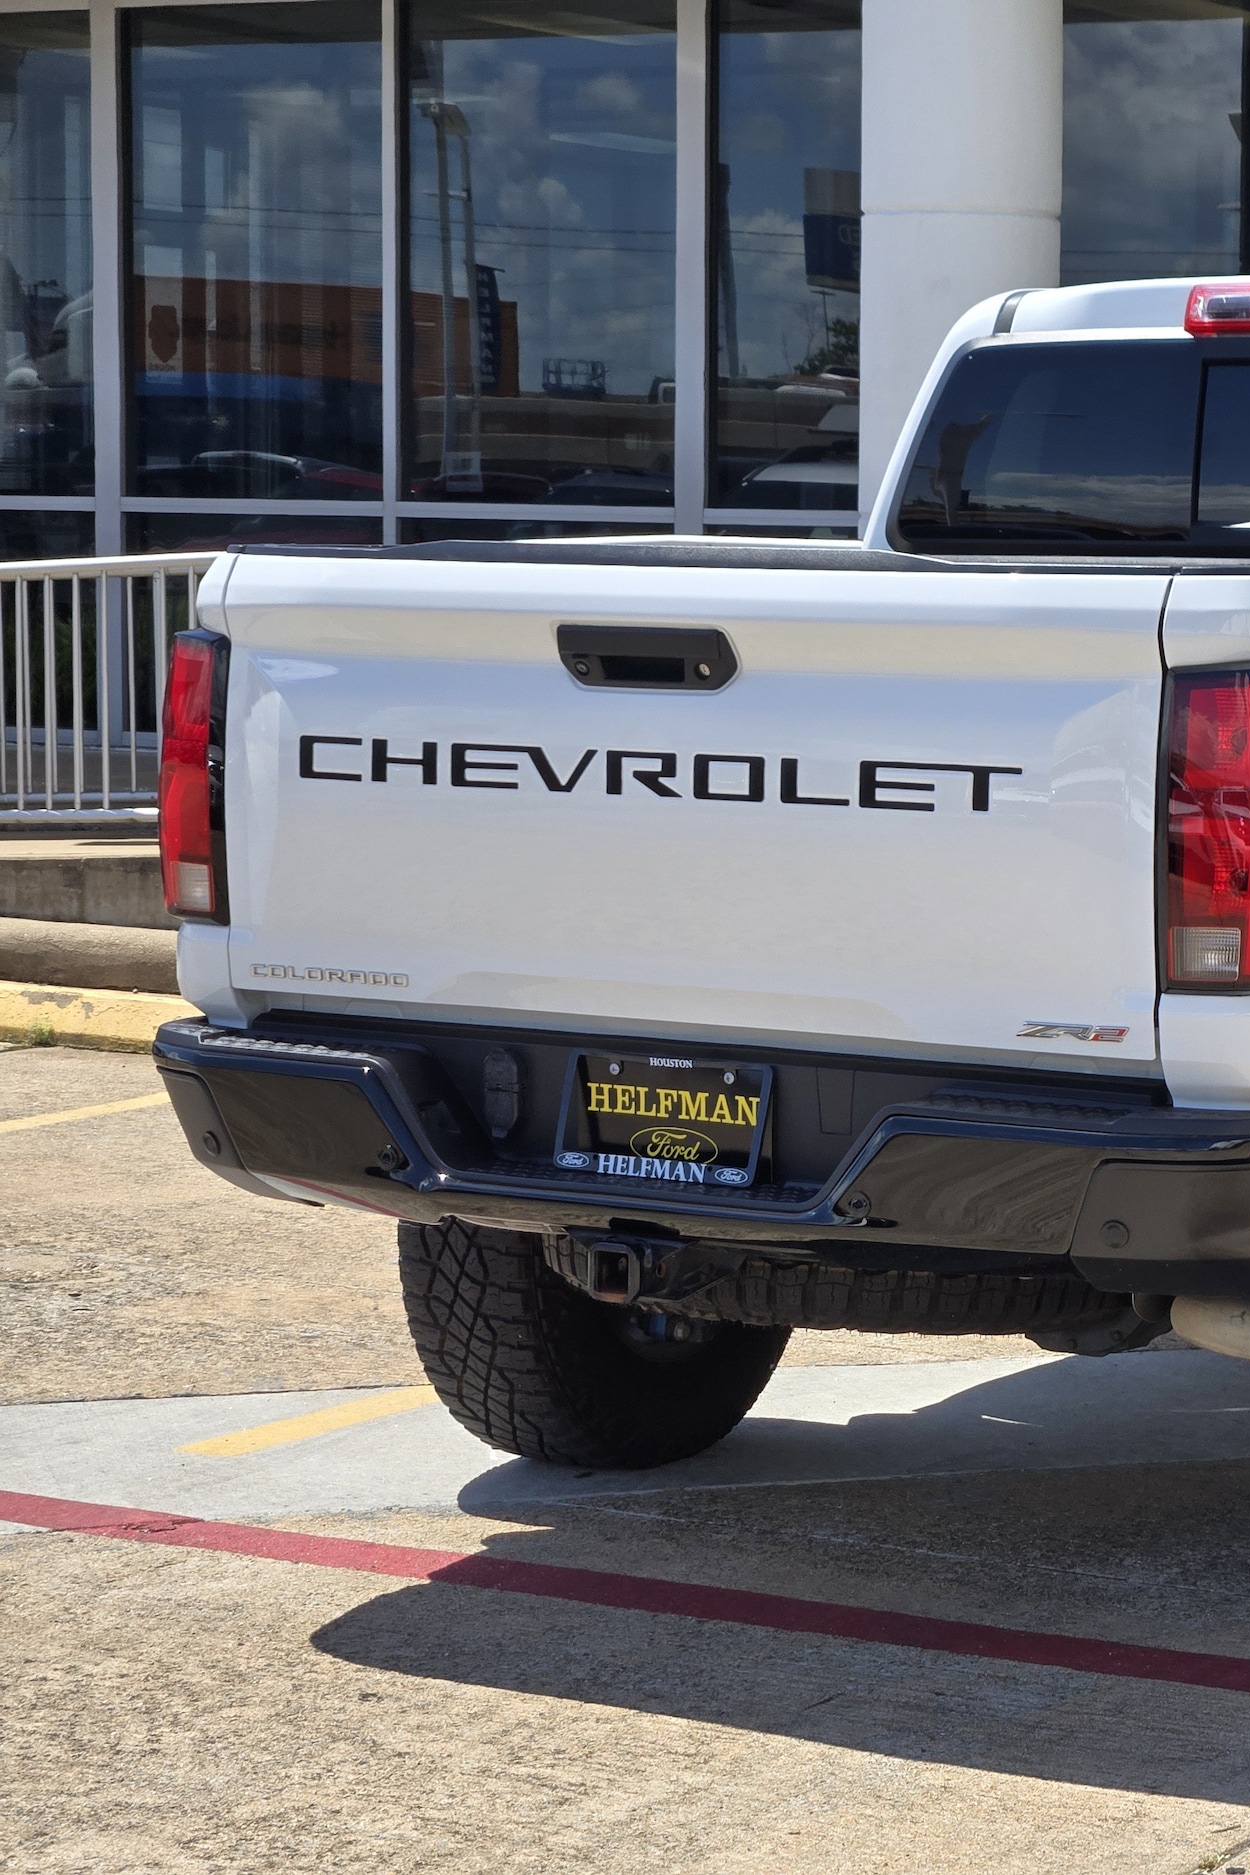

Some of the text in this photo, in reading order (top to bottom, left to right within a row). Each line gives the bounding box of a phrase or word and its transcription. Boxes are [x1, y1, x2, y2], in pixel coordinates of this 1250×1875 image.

[299, 734, 1023, 812] CHEVROLET
[250, 963, 409, 988] COLORADO
[1016, 1021, 1130, 1042] ZR2
[649, 1057, 693, 1069] HOUSTON
[587, 1082, 760, 1126] HELFMAN
[647, 1131, 700, 1161] Ford
[597, 1153, 707, 1183] HELFMAN
